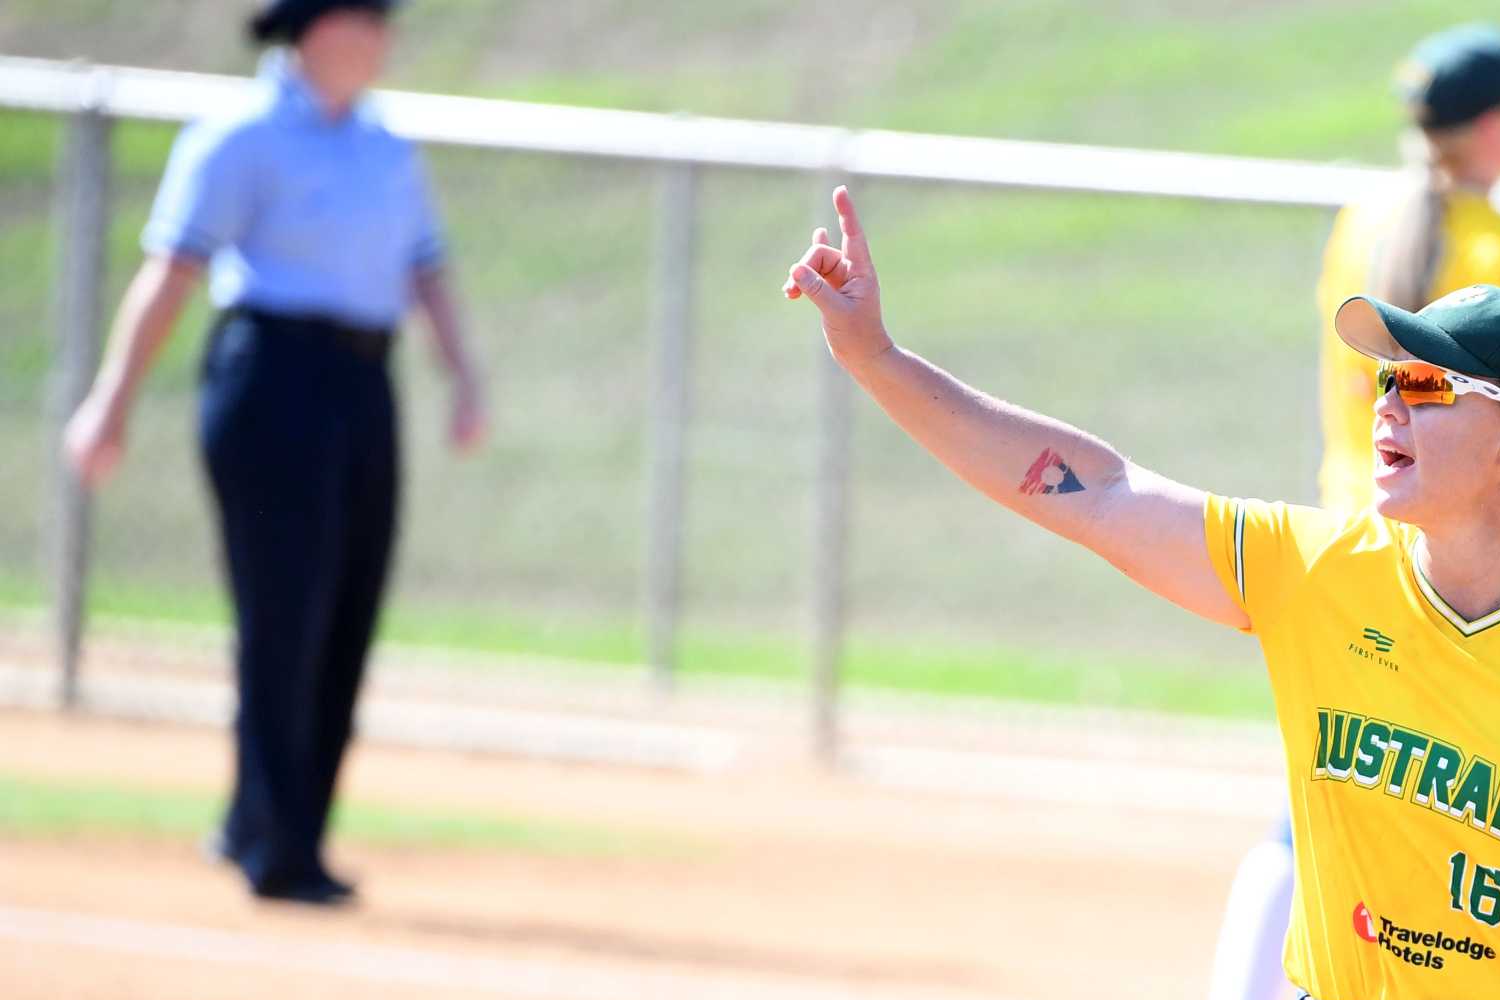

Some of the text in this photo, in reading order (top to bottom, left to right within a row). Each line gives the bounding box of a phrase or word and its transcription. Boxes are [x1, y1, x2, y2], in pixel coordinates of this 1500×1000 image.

[1348, 642, 1399, 673] FIRST EVER
[1378, 931, 1444, 970] Hotels
[1379, 915, 1497, 960] Travelodge
